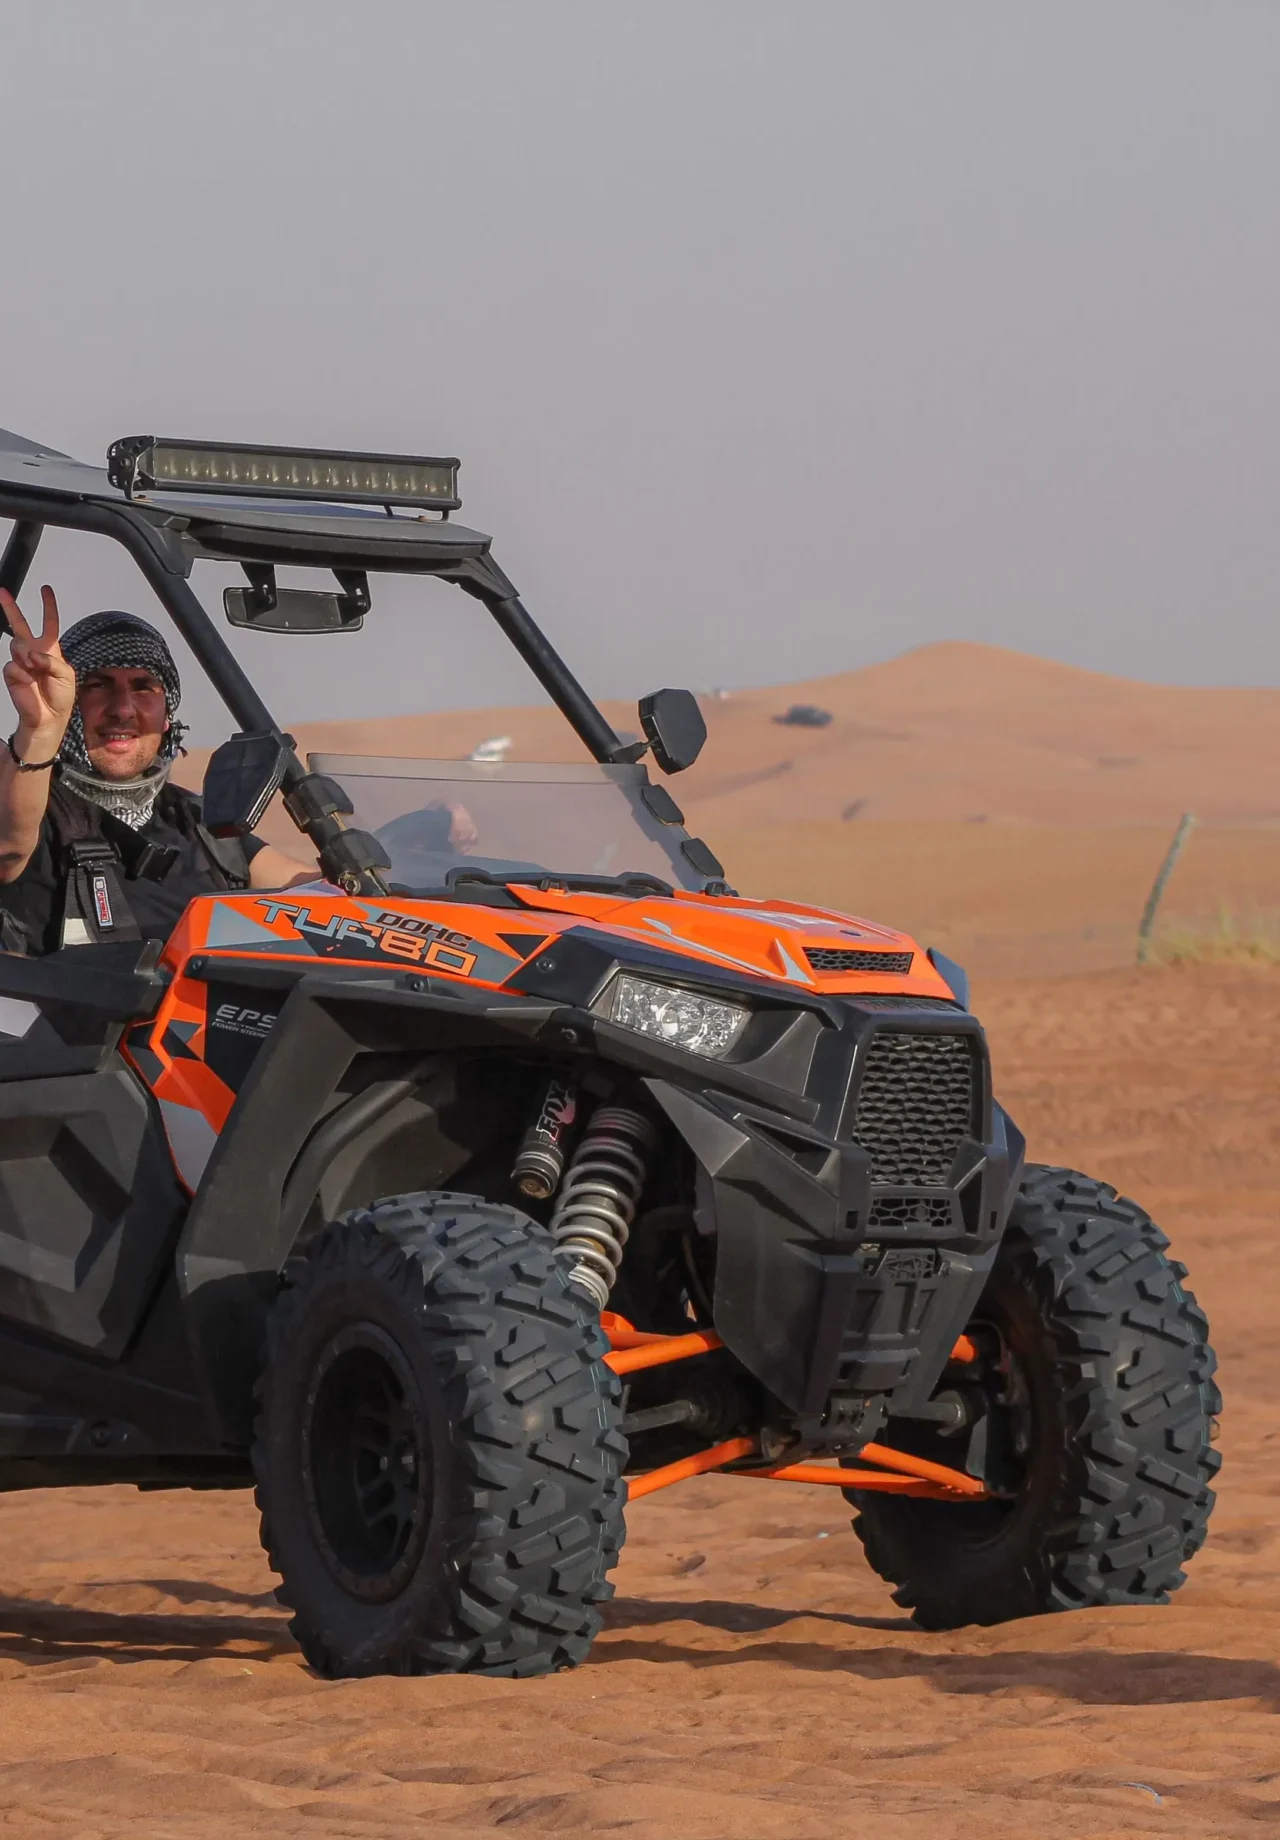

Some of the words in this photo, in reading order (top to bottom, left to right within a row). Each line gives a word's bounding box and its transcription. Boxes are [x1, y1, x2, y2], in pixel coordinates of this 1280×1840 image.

[254, 899, 478, 977] TURBO
[376, 912, 474, 949] DOHC
[216, 1004, 277, 1029] EPS
[535, 1079, 572, 1141] FOX
